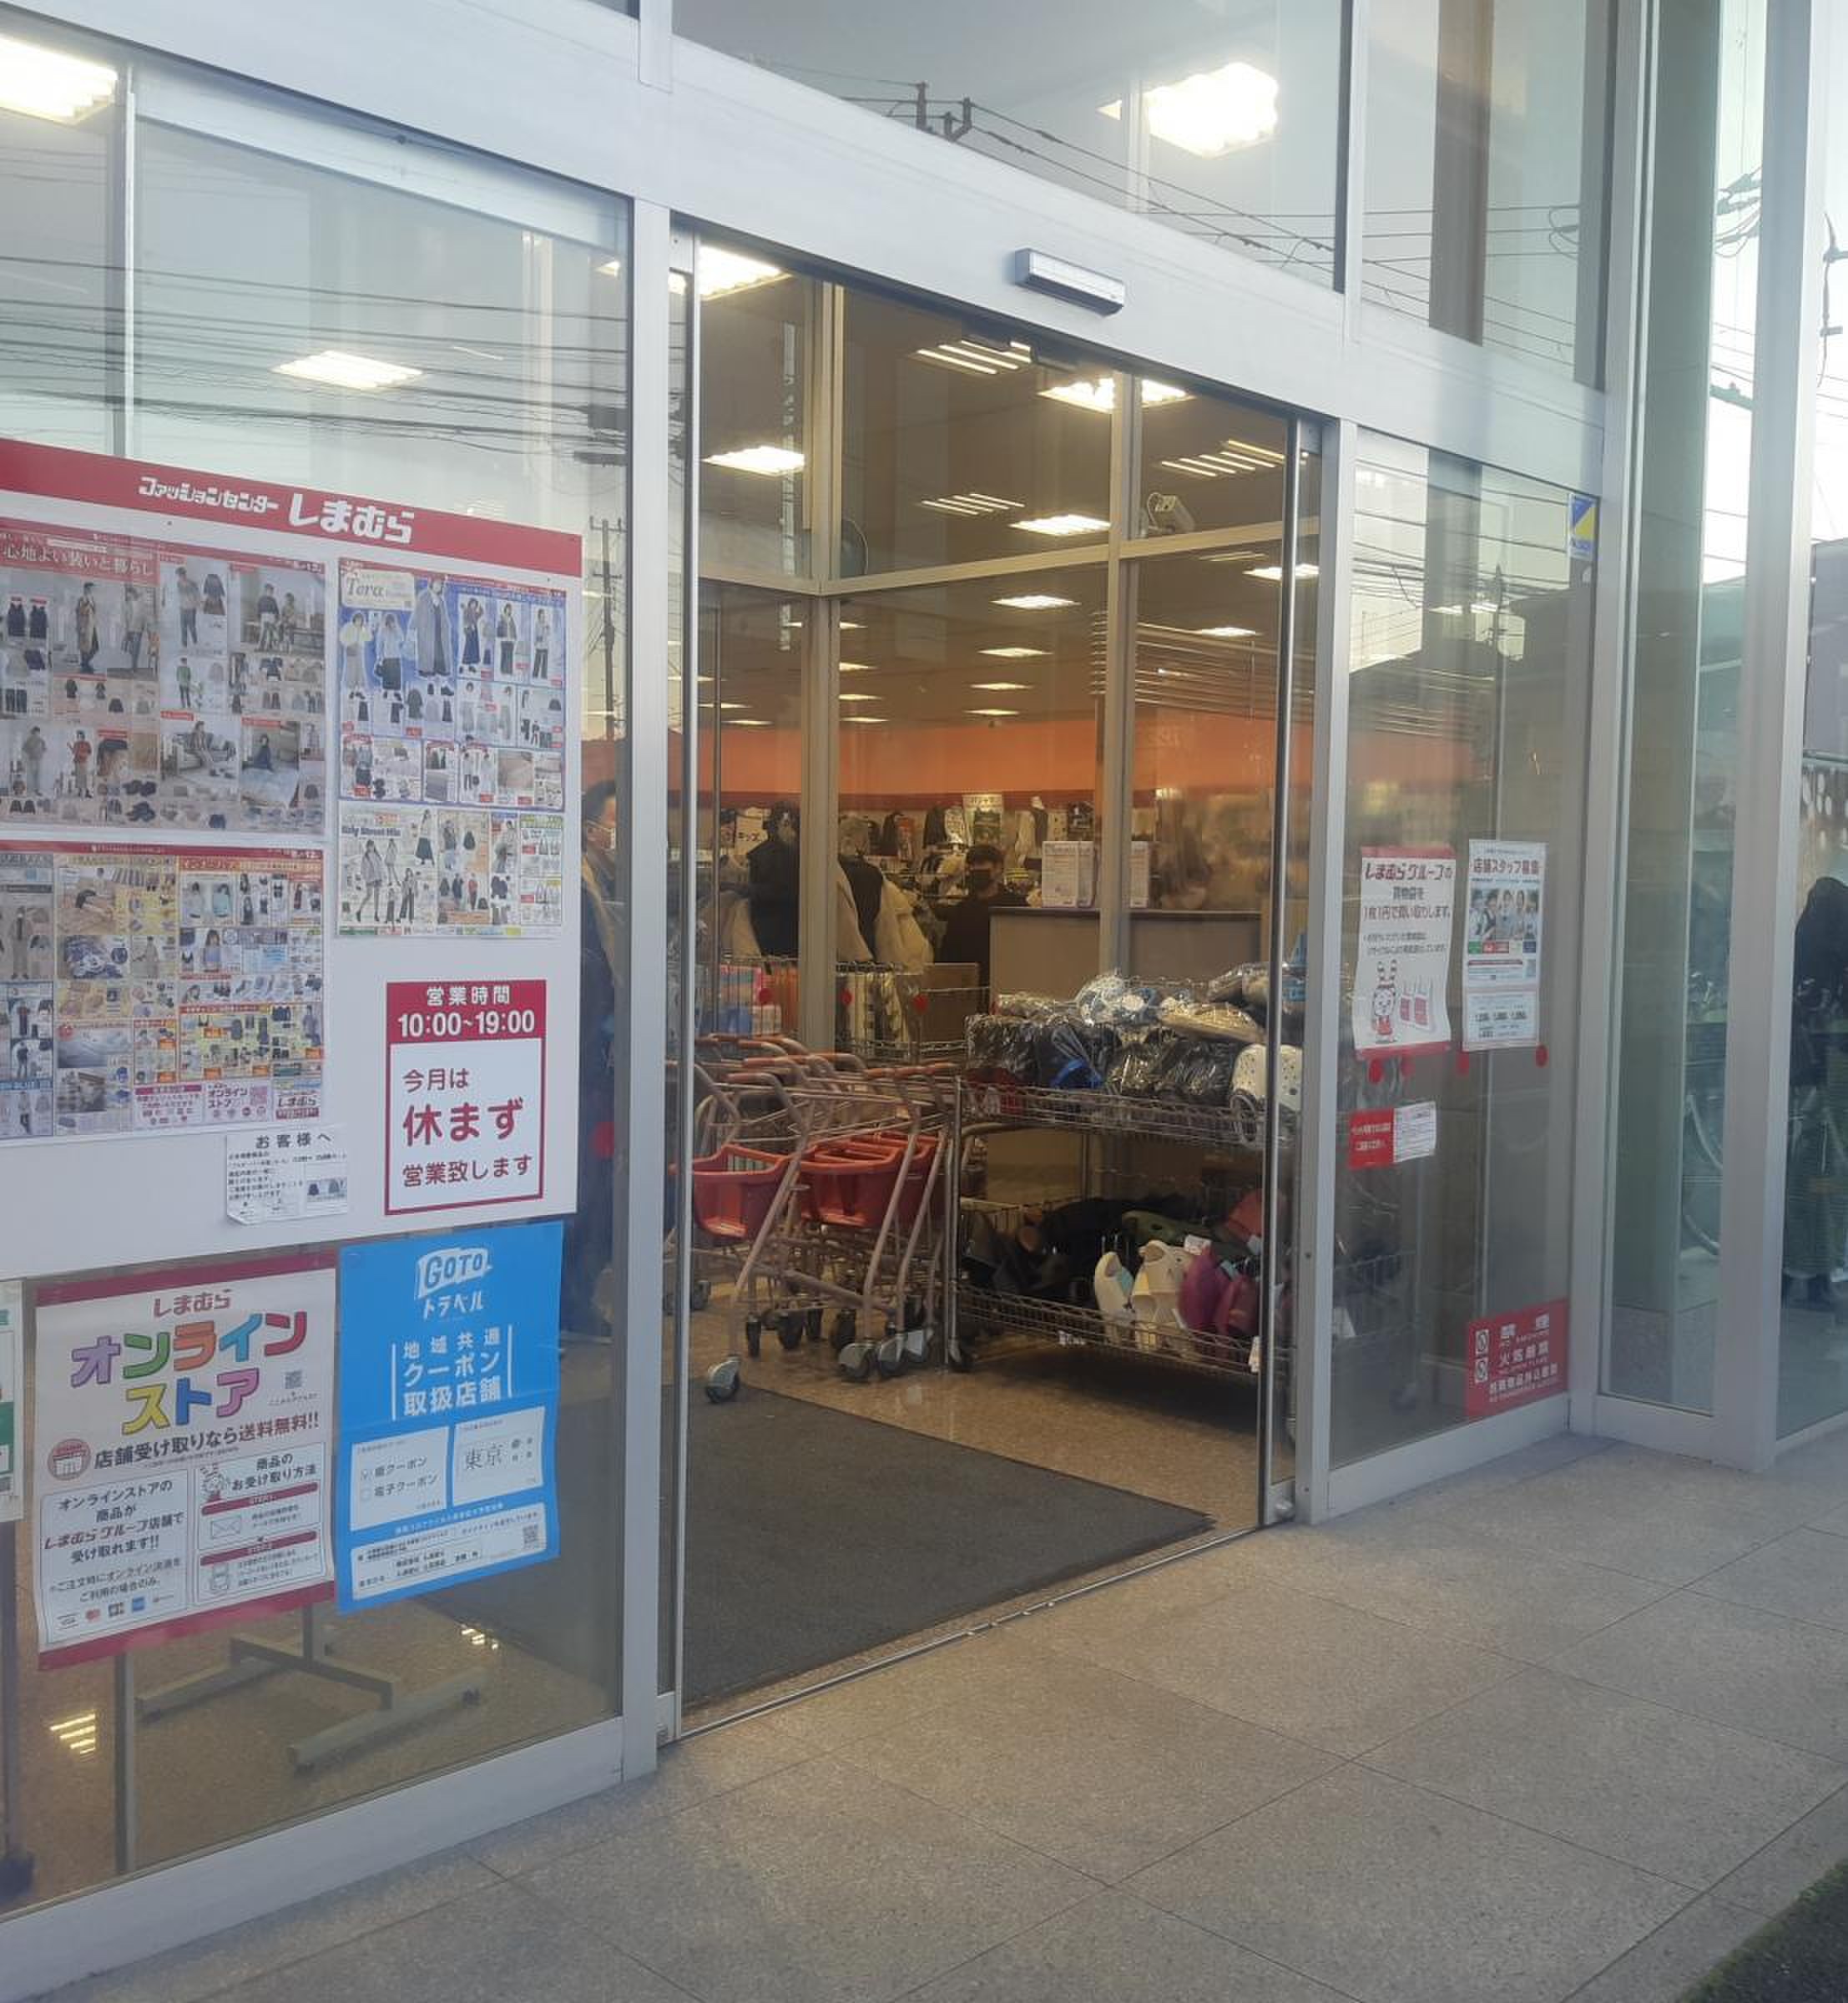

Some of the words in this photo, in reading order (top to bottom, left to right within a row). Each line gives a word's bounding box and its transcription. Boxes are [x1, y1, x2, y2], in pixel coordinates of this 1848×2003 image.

[139, 476, 279, 513] ファッションセンター
[289, 492, 415, 544] しまむら
[427, 985, 511, 1007] 営業時間
[402, 1067, 469, 1093] 今月は
[402, 1096, 524, 1148] 休まず
[402, 1153, 533, 1188] 営業致します
[154, 1288, 233, 1318] しまむら
[422, 1291, 484, 1320] トラベル
[70, 1310, 307, 1388] オンライン
[404, 1327, 501, 1360] 地域共通
[404, 1351, 500, 1387] クーポン
[121, 1367, 260, 1435] ストア
[404, 1375, 502, 1417] 取扱店舗
[58, 1480, 173, 1511] オンラインストアの
